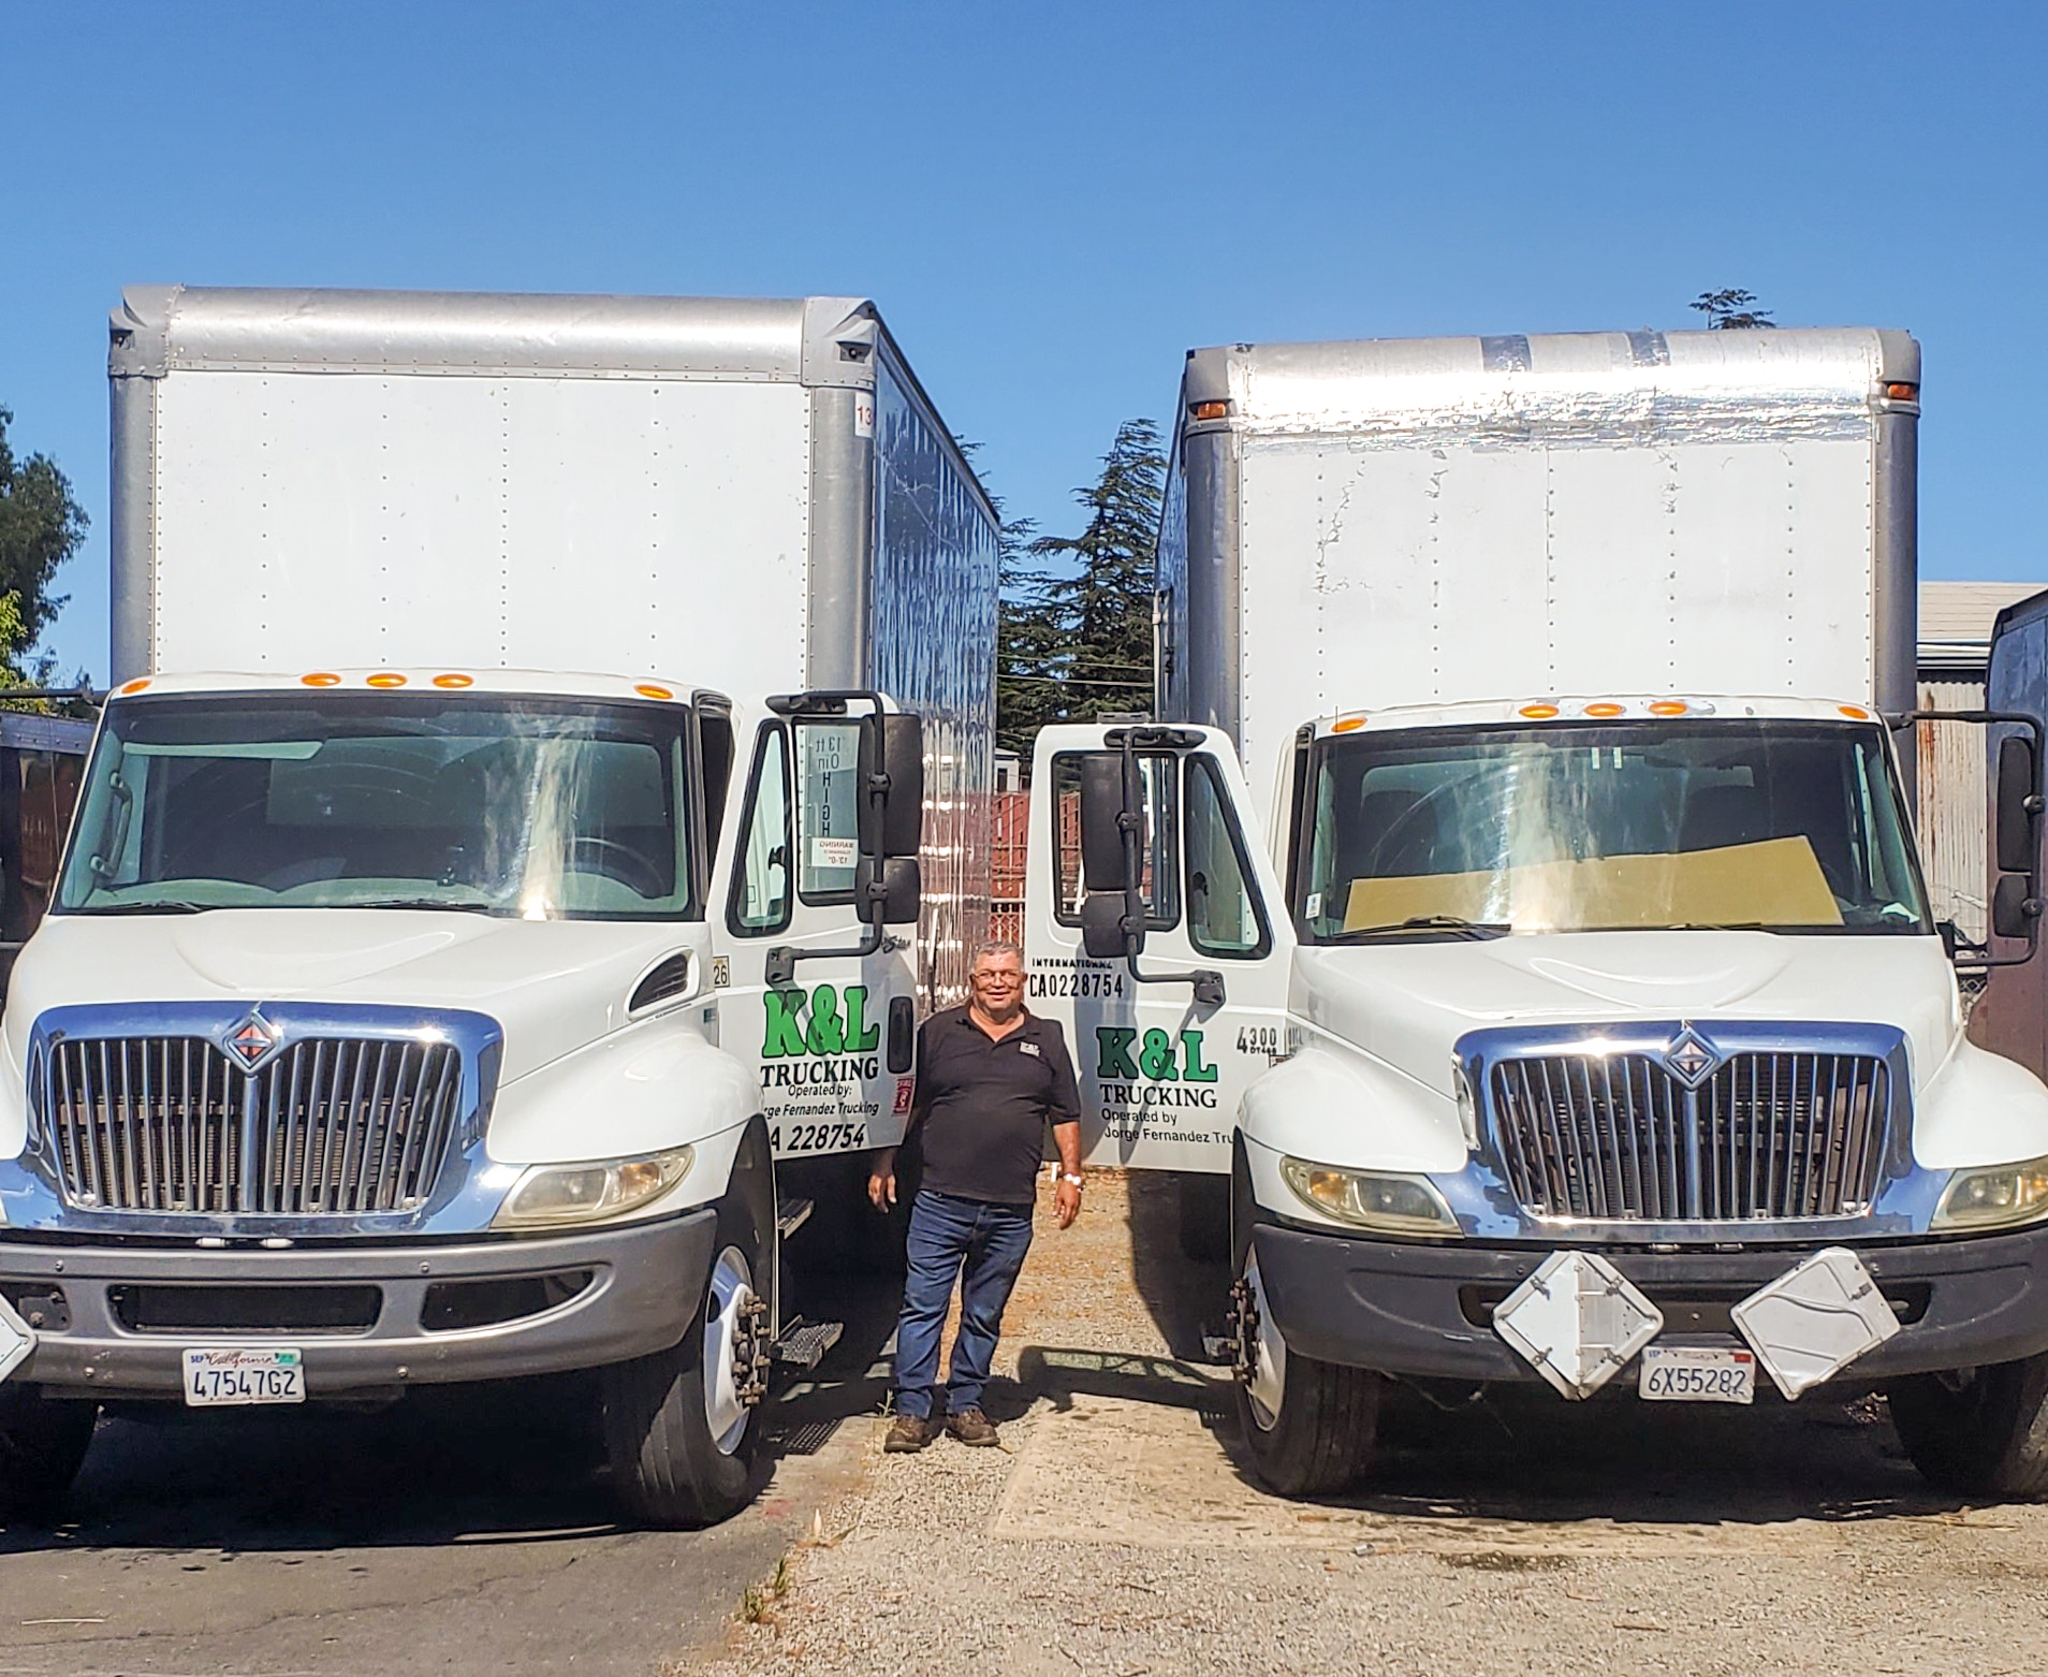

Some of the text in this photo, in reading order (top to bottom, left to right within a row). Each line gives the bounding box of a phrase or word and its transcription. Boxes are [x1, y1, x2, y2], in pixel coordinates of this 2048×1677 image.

[713, 964, 728, 985] 26
[1032, 957, 1113, 970] INTERNATIONAL
[1030, 973, 1123, 998] CA0228754
[761, 984, 881, 1059] K&L
[1236, 1026, 1277, 1054] 4300
[1096, 1026, 1218, 1083] K&L
[760, 1057, 880, 1088] TRUCKING
[788, 1083, 852, 1099] Operated by:
[1099, 1084, 1218, 1109] TRUCKING
[782, 1102, 836, 1117] Fernandez
[838, 1101, 880, 1117] Trucking
[1101, 1108, 1177, 1126] Operated by
[787, 1123, 866, 1151] 228754
[1104, 1126, 1140, 1142] Jorge
[1143, 1128, 1210, 1143] Fernandez
[194, 1370, 298, 1397] 47547G2
[1648, 1367, 1747, 1396] 6X55282
